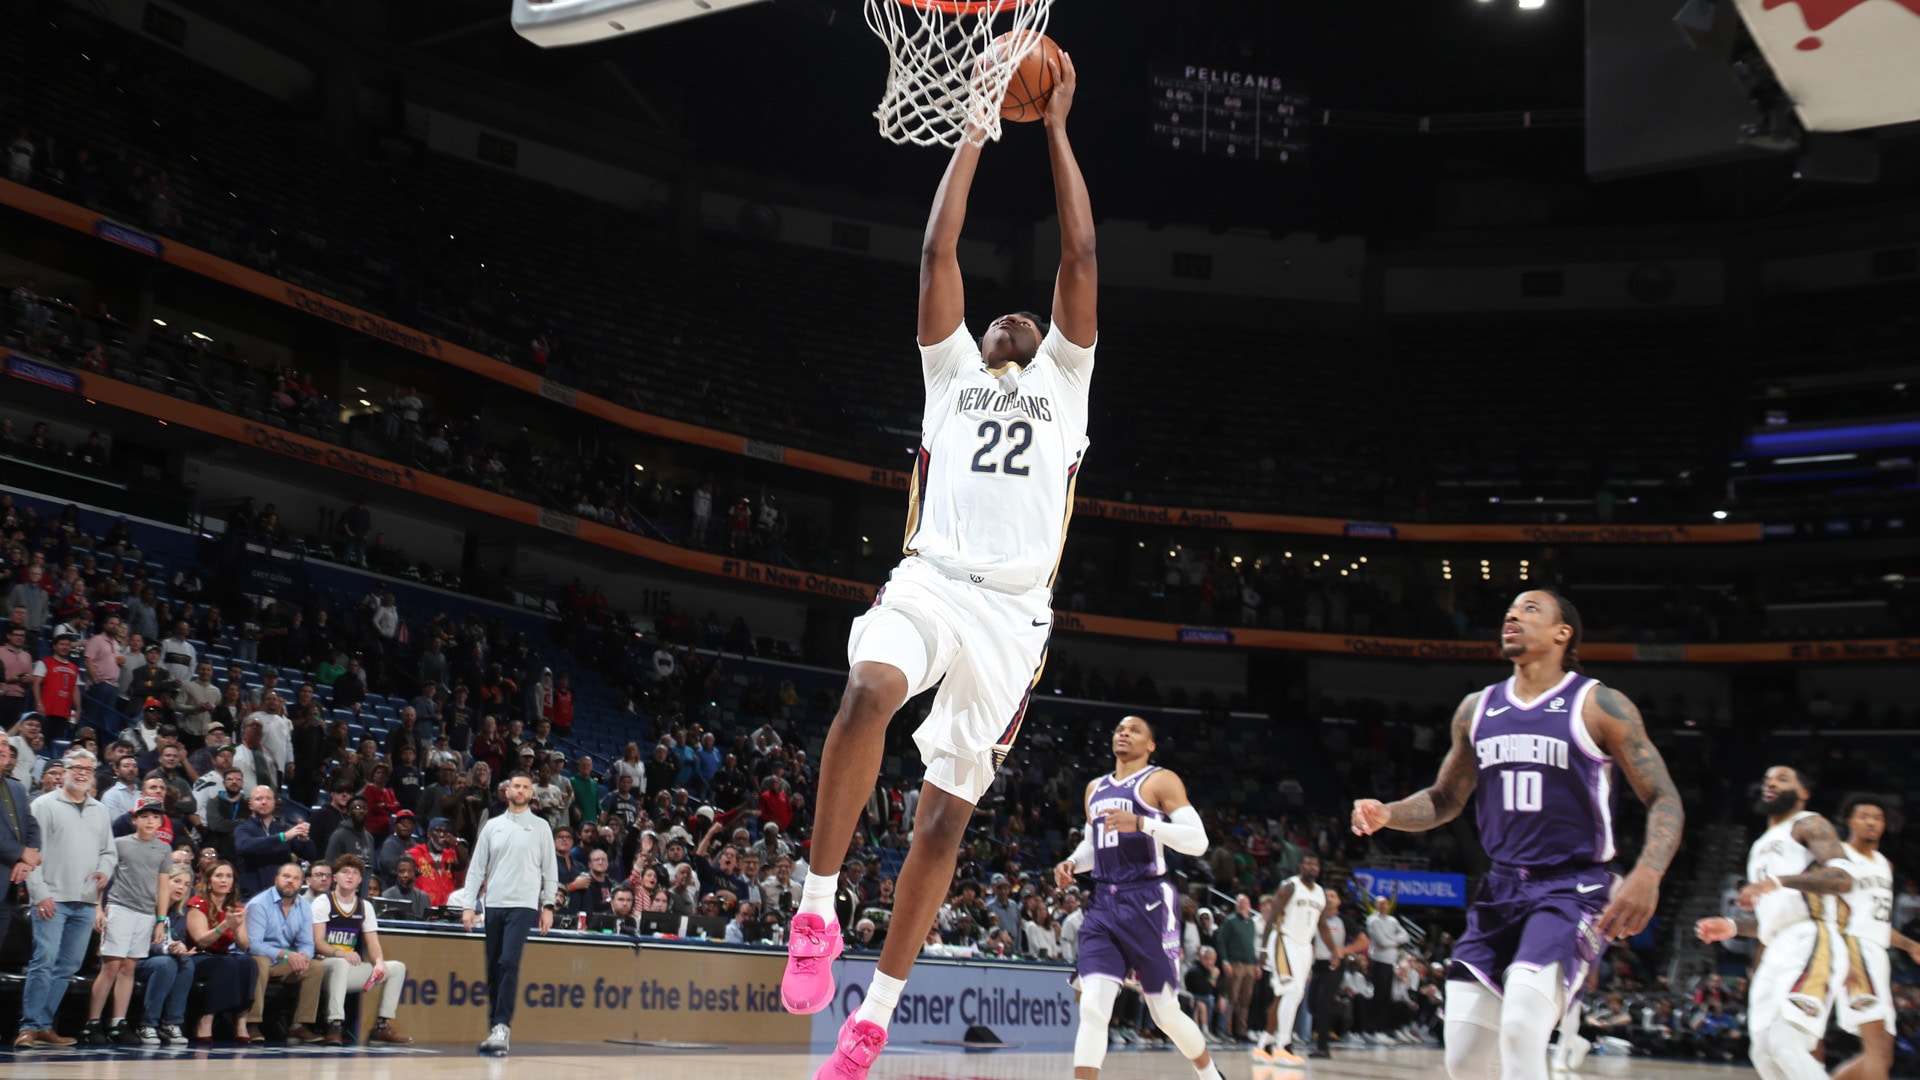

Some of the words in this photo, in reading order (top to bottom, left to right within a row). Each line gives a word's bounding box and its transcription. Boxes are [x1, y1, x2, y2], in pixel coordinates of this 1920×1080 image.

[1184, 65, 1282, 92] PELICANS
[956, 387, 997, 415] NEW
[993, 386, 1052, 422] ORLANS
[253, 428, 321, 462] Ochsner
[326, 448, 402, 486] Children's
[971, 420, 1033, 476] 22
[1112, 507, 1172, 522] ranked.
[1178, 510, 1232, 527] Again.
[722, 559, 741, 578] #1
[746, 563, 760, 579] in
[765, 568, 799, 587] New
[805, 575, 870, 600] Orleans.
[643, 588, 671, 616] 115
[1055, 612, 1085, 630] ain.
[1475, 733, 1569, 770] SACRAMENTO
[1501, 770, 1543, 812] 10
[401, 970, 439, 1005] he
[448, 971, 488, 1007] be
[523, 982, 586, 1009] care
[593, 977, 632, 1010] for
[640, 979, 680, 1010] the
[688, 981, 739, 1012] best
[959, 988, 1072, 1026] Children's
